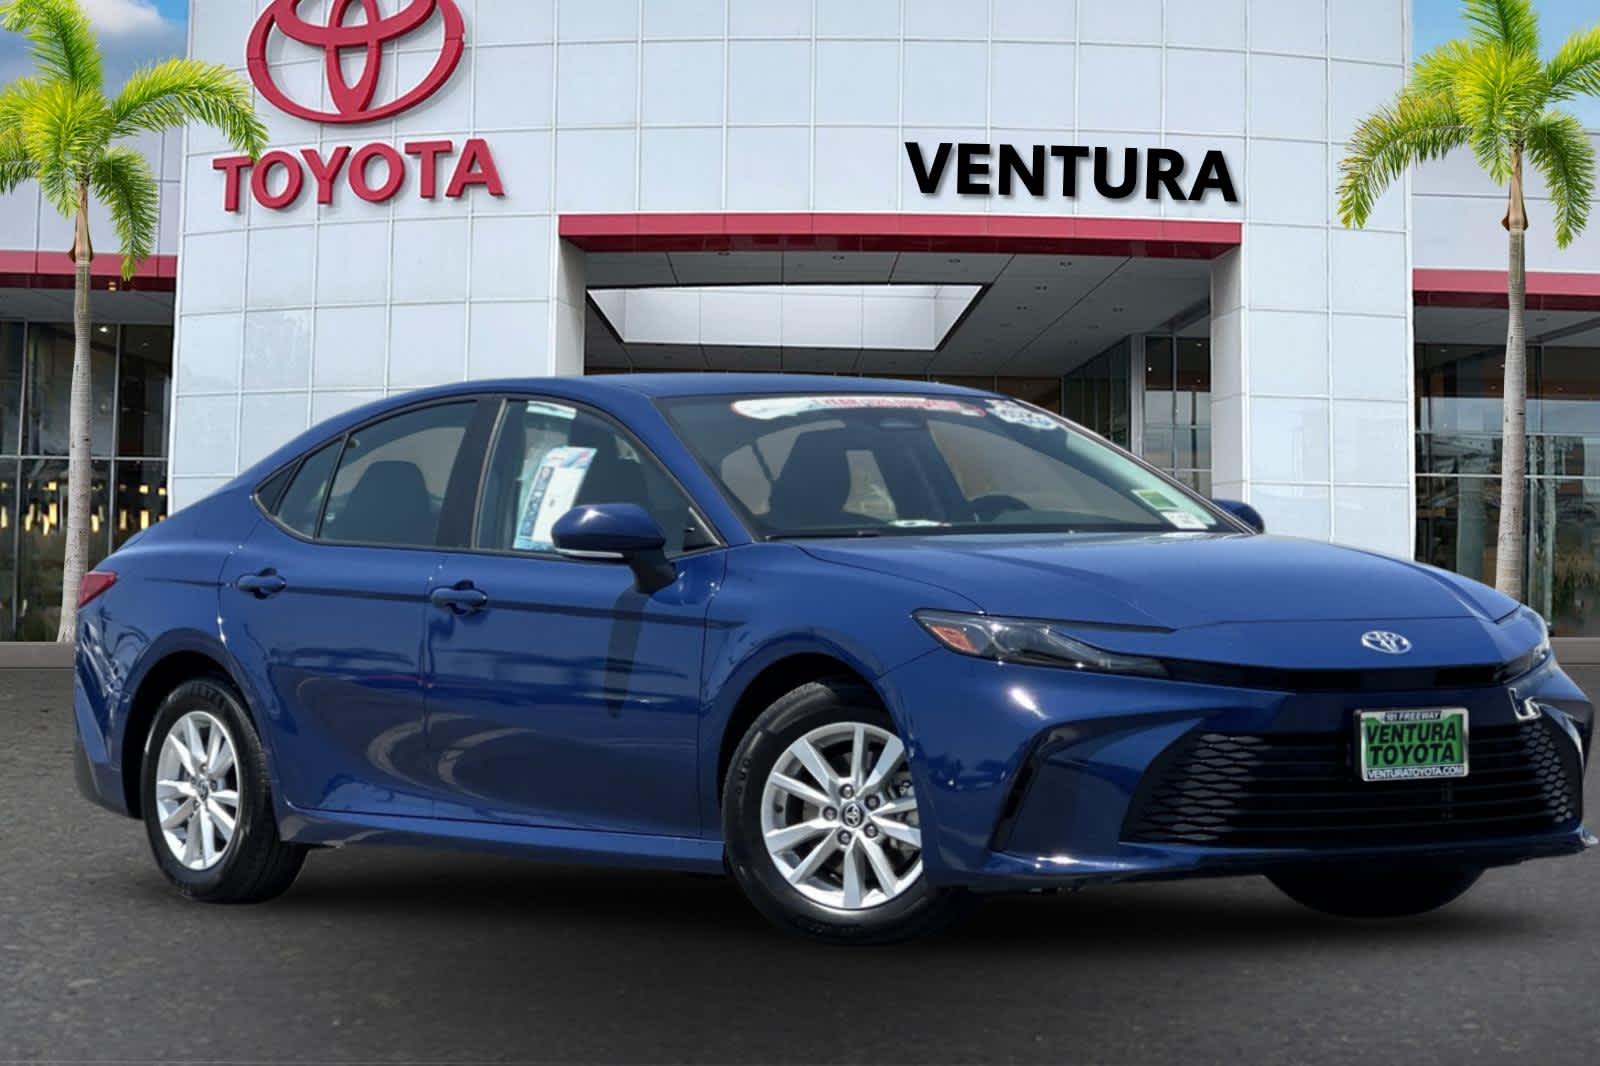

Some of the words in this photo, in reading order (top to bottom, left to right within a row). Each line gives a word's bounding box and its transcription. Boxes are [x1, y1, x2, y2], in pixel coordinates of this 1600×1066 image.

[212, 138, 505, 212] TOYOTA
[905, 142, 1238, 202] VENTURA
[1366, 722, 1457, 744] VENTURA
[1369, 743, 1455, 766] TOYOTA
[1367, 766, 1463, 779] VENTURATOYOTA.COM
